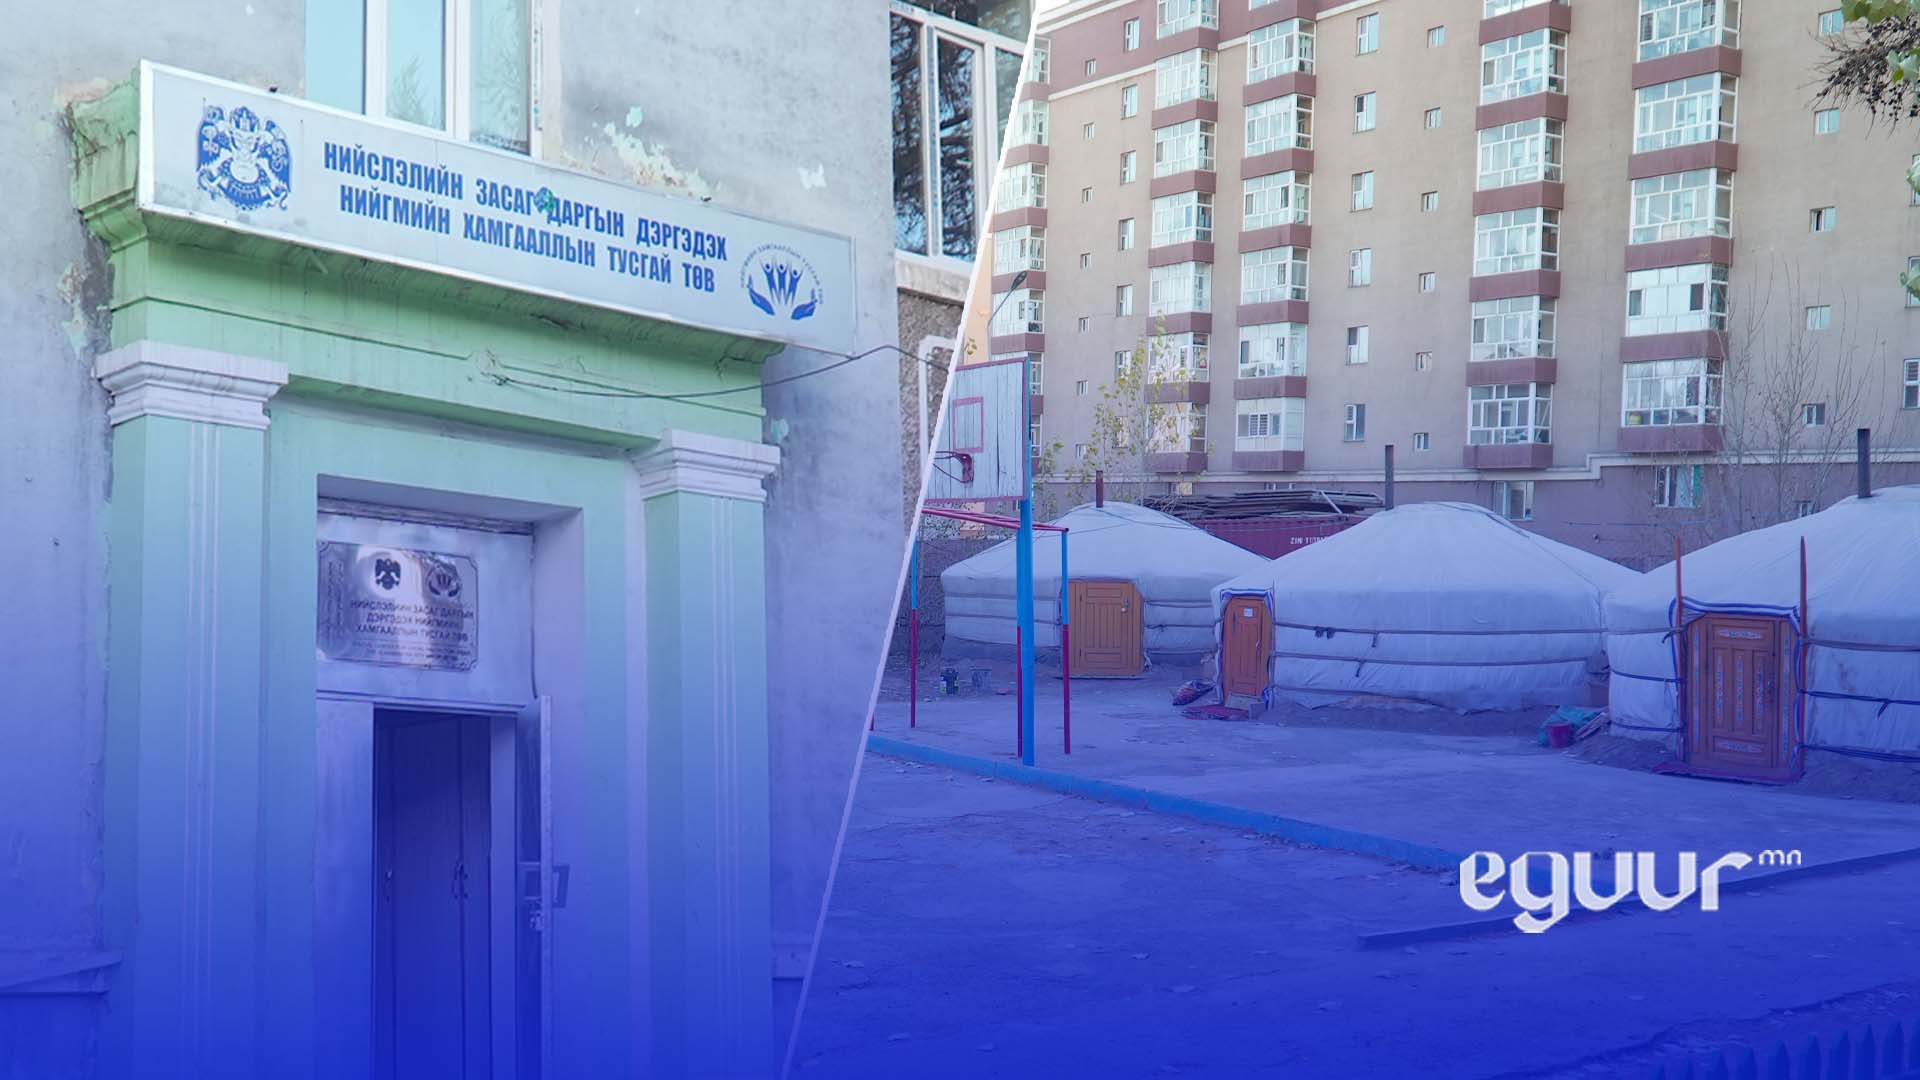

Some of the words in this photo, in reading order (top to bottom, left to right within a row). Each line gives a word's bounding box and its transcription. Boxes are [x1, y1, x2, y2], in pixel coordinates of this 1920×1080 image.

[324, 142, 463, 200] НИЙСЛЭЛИЙН
[476, 178, 534, 215] ЗАСАГ
[547, 197, 624, 237] ДАРГЫН
[636, 217, 727, 261] ДЭРГЭДЭХ
[340, 184, 450, 235] НИЙГМИЙН
[463, 212, 595, 267] ХАМГААЛЛЫН
[608, 246, 671, 283] ТУСГАЙ
[682, 262, 715, 293] ТӨВ
